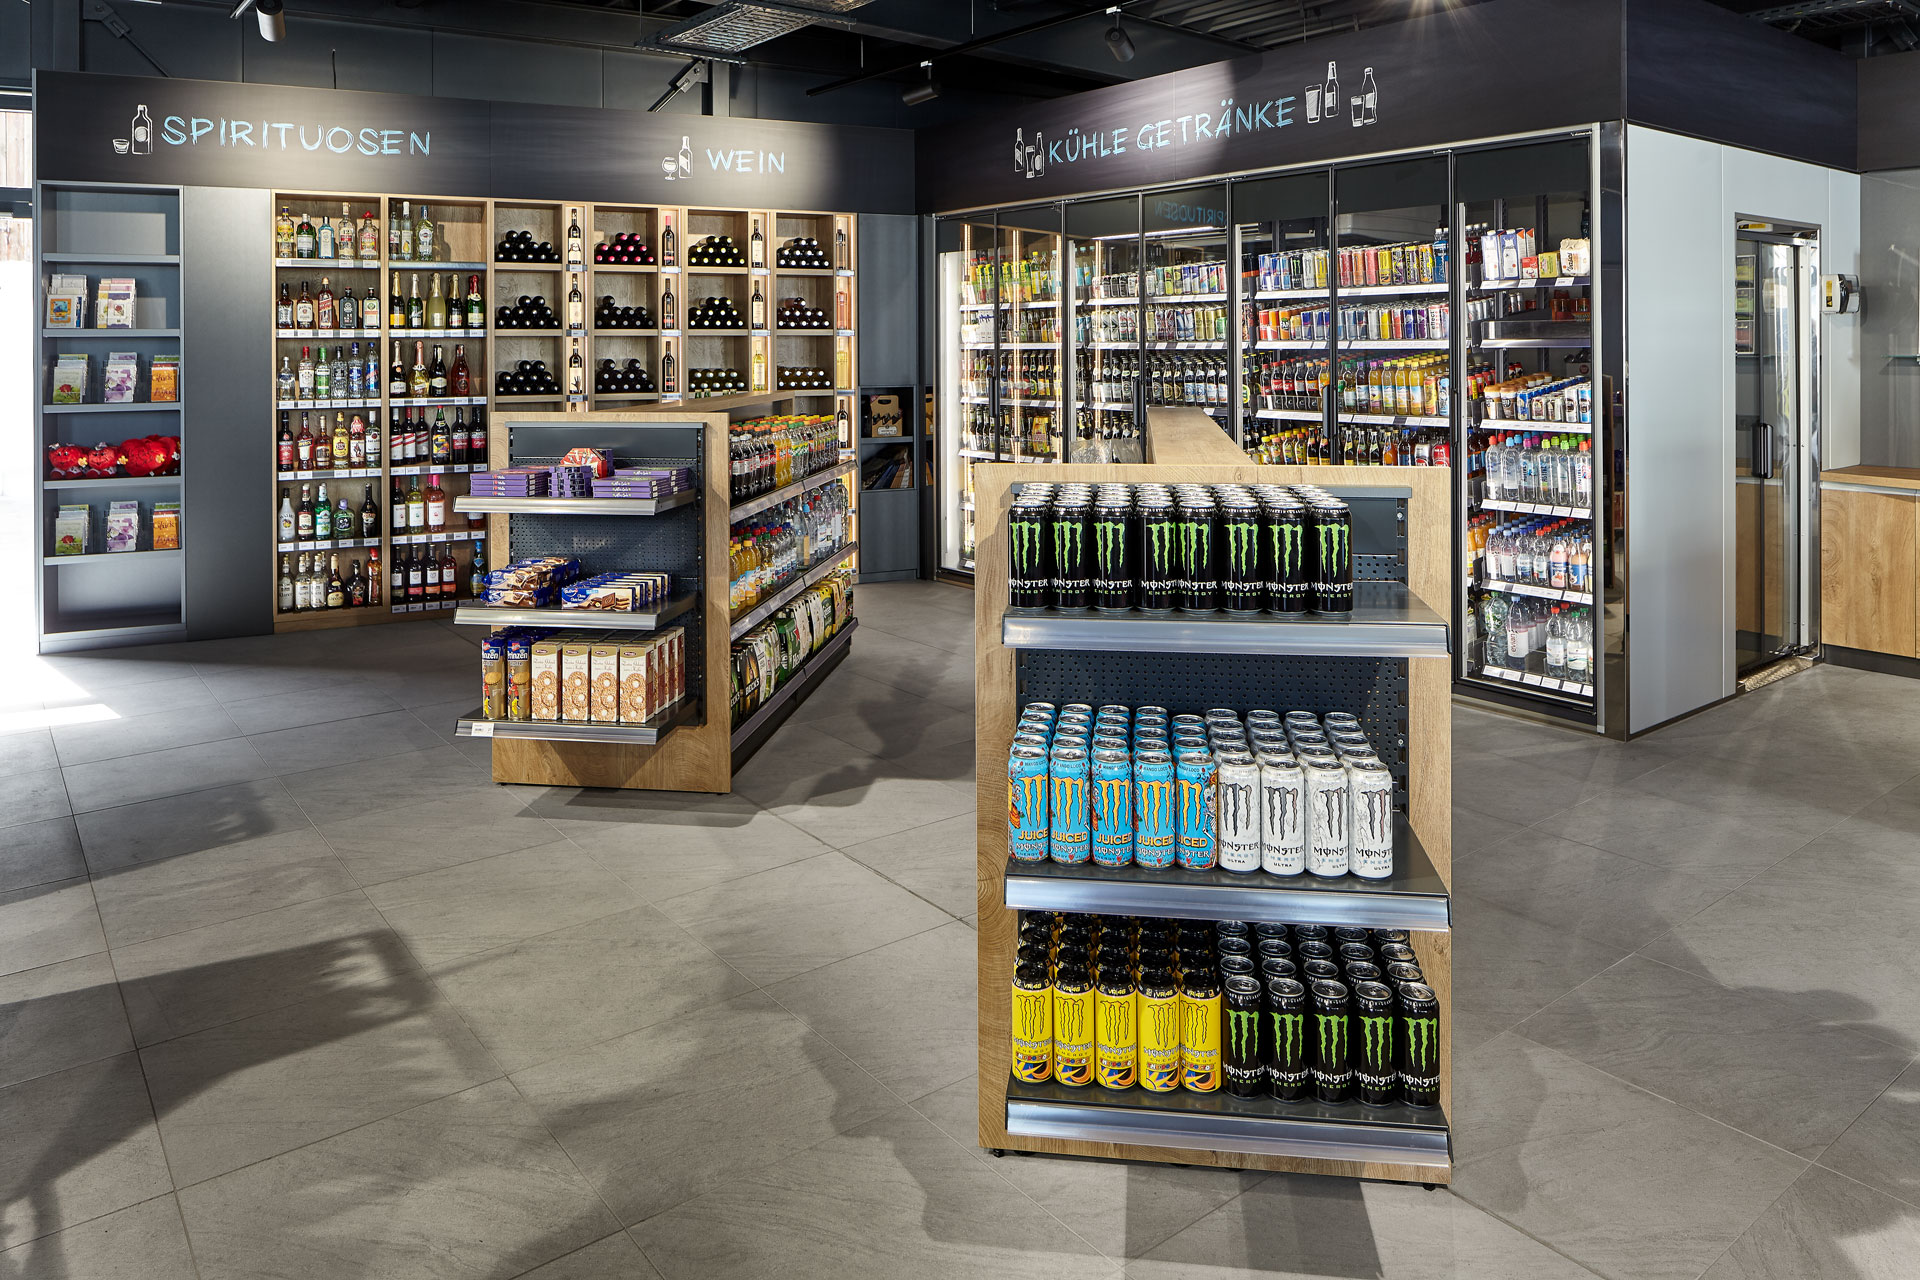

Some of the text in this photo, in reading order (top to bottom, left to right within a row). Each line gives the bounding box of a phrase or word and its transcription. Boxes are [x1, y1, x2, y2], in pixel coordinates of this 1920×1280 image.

[161, 115, 431, 157] SPIRITUOSEN
[1049, 97, 1297, 165] KÜHLE GETRÄNKE
[706, 148, 785, 174] WEIN
[1141, 580, 1177, 590] MONST
[507, 650, 529, 660] rinzen
[1018, 828, 1048, 841] JUICE
[1051, 830, 1089, 843] JUICED
[1096, 832, 1133, 845] JUICED
[1137, 834, 1175, 847] JUICED
[1016, 841, 1048, 852] MONST
[1177, 835, 1208, 848] UICED
[1095, 845, 1133, 856] MONSTE
[1136, 846, 1175, 858] MONSTE
[1177, 846, 1210, 858] NSTER
[1313, 846, 1349, 857] MONST
[1355, 847, 1392, 859] MONST
[1398, 1071, 1440, 1087] MONSTE
